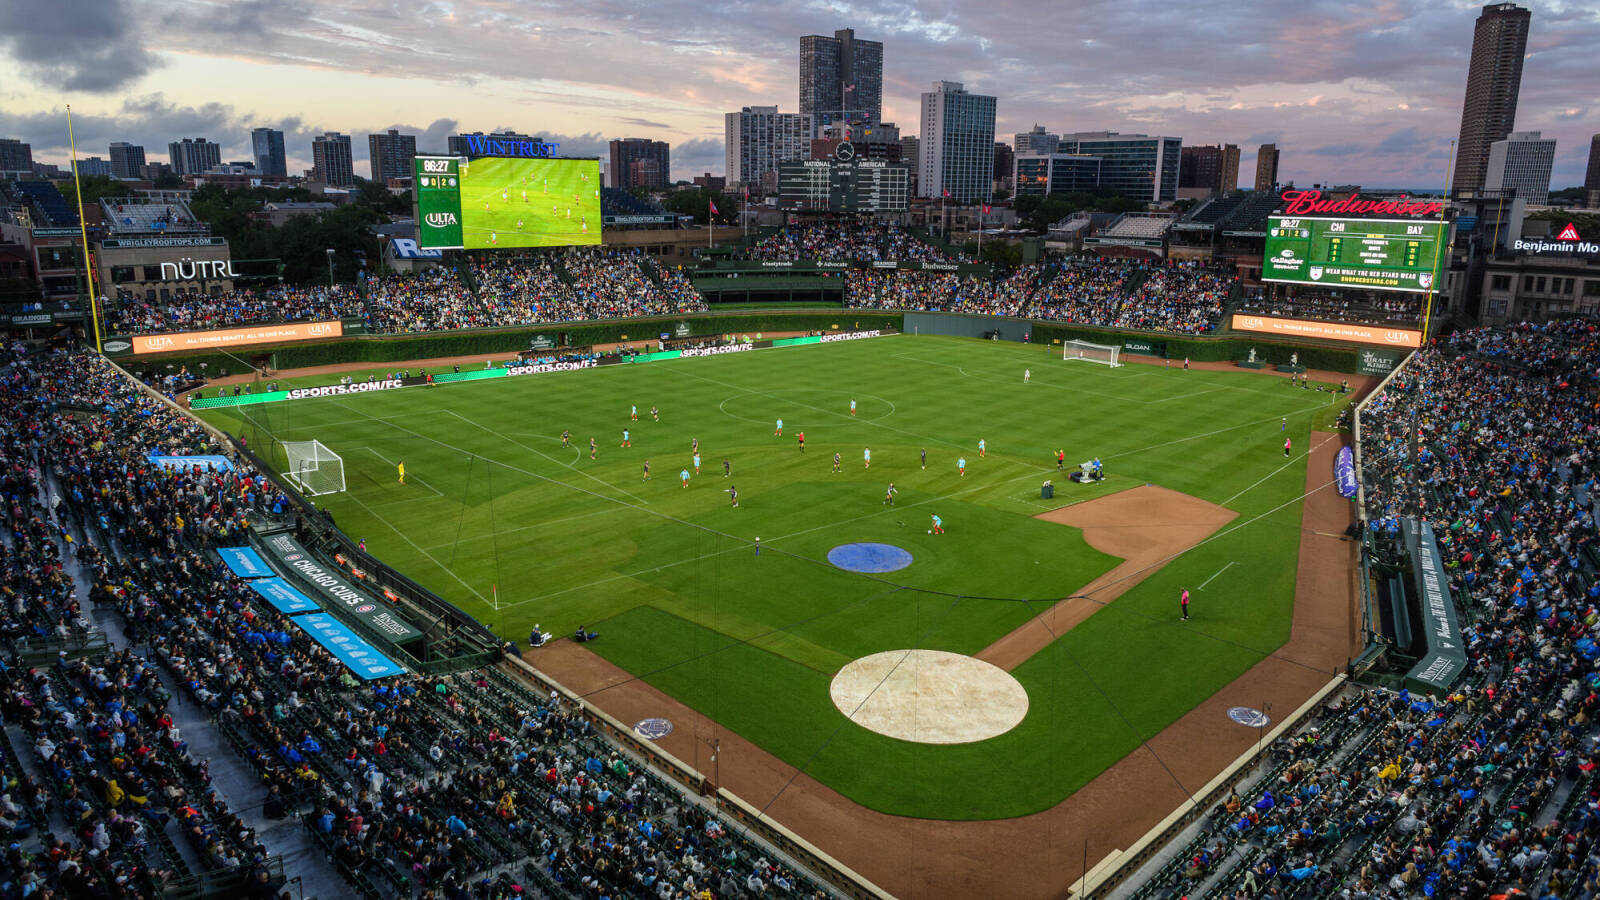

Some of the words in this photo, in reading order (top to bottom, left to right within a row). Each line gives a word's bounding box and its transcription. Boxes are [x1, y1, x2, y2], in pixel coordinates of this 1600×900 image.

[465, 136, 560, 156] WINTRUST
[424, 160, 449, 172] 86:27
[441, 178, 446, 186] 2
[1281, 190, 1445, 215] Budweiser
[428, 213, 457, 226] ULTA
[1330, 222, 1345, 232] CHI
[1407, 226, 1424, 236] BAY
[118, 239, 211, 247] WRIGLEYROOFTOPS.COM
[1514, 240, 1573, 253] Benjamin
[1270, 257, 1304, 265] Gallagher
[922, 263, 959, 271] Budweiser
[147, 336, 174, 347] ULTA
[1386, 332, 1409, 342] ULTA
[293, 559, 338, 587] CHICAGO
